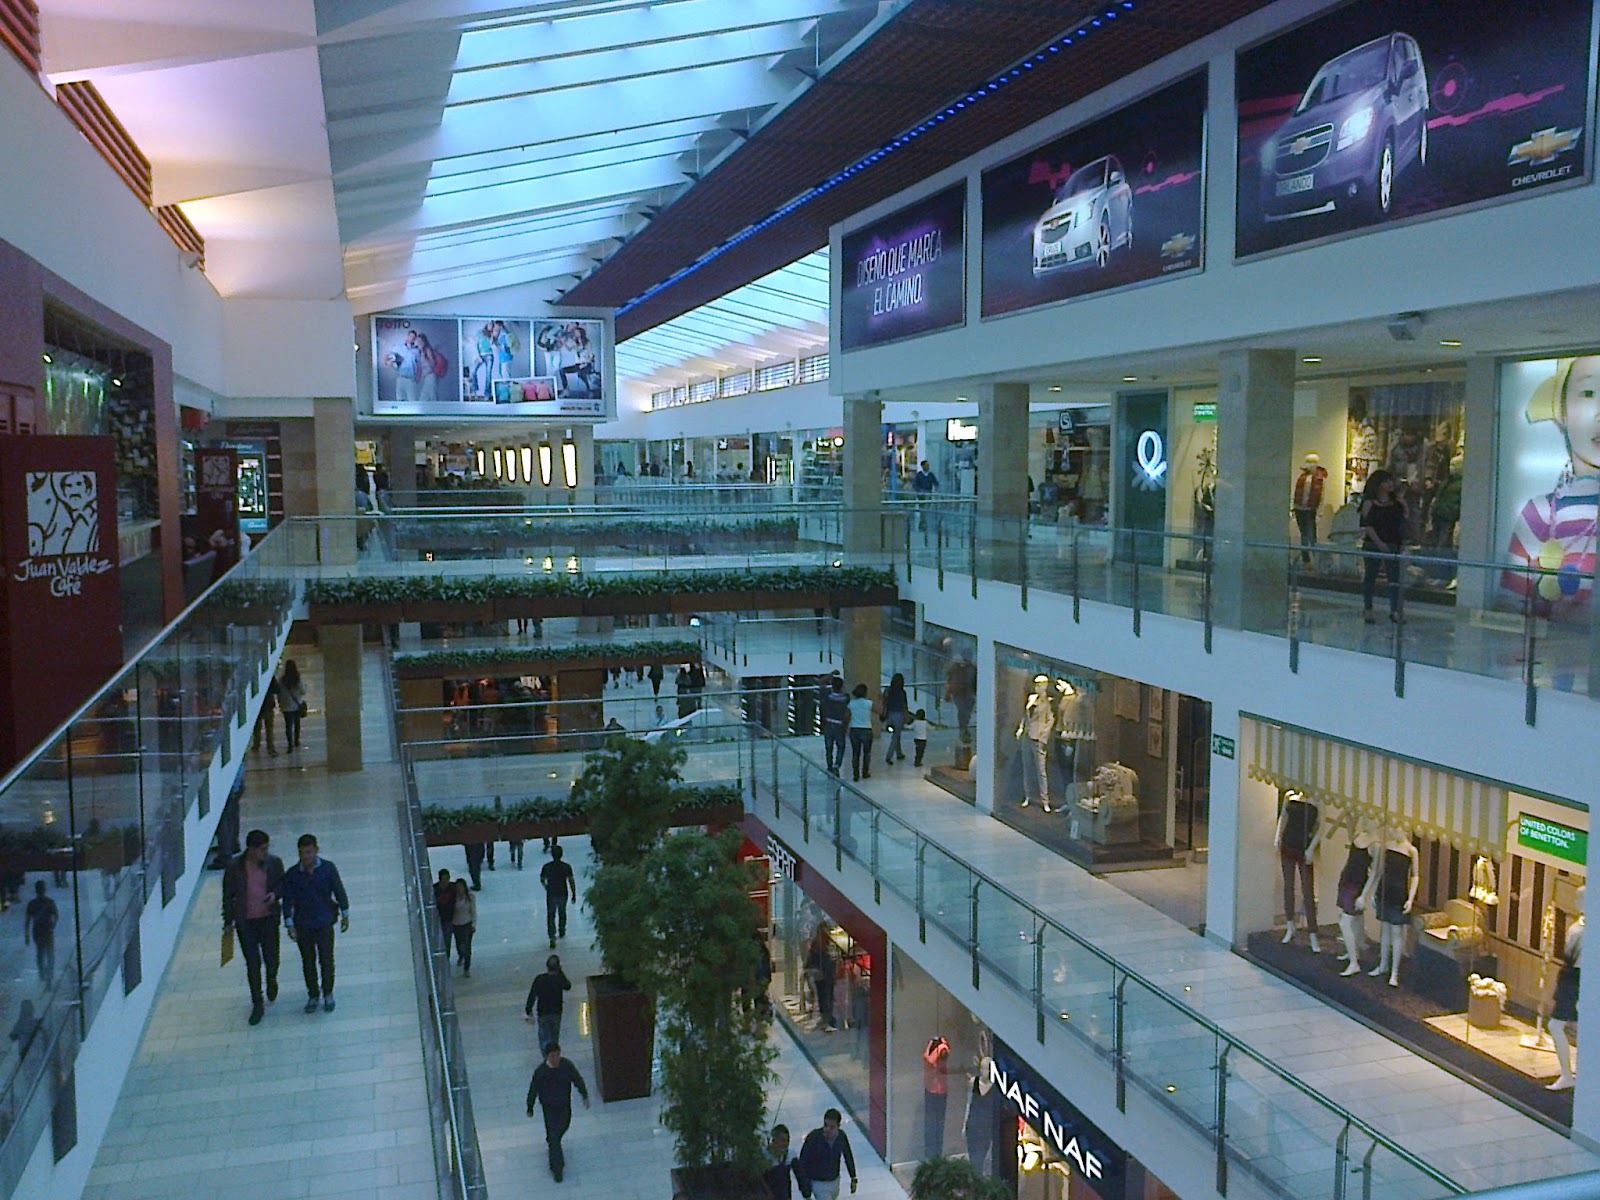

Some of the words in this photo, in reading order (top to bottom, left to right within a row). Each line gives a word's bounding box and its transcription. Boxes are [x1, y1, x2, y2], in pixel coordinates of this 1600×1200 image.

[1511, 165, 1571, 187] CHEVROLET
[857, 248, 887, 287] DISEÑO
[888, 242, 907, 279] QUE
[908, 230, 942, 268] MARCA
[873, 286, 884, 315] EL
[14, 558, 57, 582] Juan
[57, 555, 113, 577] Valdez
[1520, 818, 1547, 832] UNITED
[1547, 825, 1576, 842] COLORS
[1520, 826, 1530, 836] OF
[767, 835, 797, 881] ESPRIT
[989, 1060, 1040, 1119] NAF
[1043, 1110, 1103, 1179] NAF
